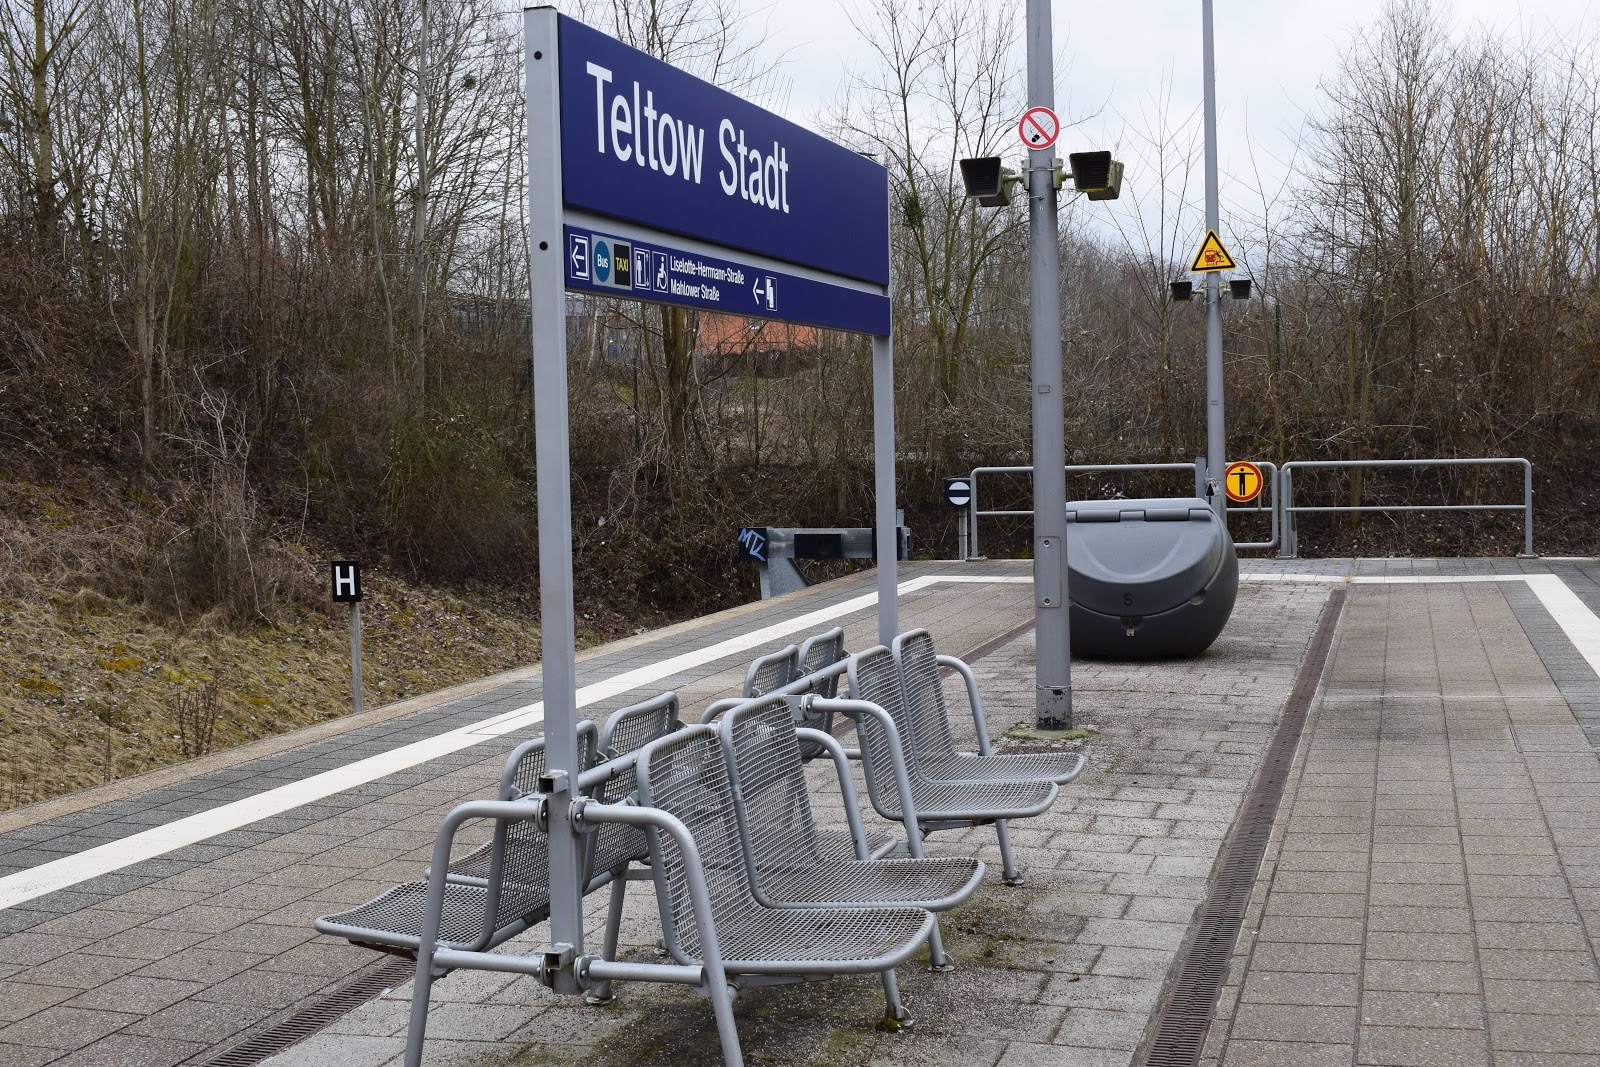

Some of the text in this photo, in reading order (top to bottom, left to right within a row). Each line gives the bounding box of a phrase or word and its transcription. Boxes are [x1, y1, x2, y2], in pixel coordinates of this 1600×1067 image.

[586, 61, 790, 214] Teltow Stadt
[597, 253, 609, 268] Bus
[615, 256, 629, 272] TAXI
[670, 255, 745, 285] Liselotte-Herrmann-Straße
[670, 278, 720, 302] Mahlower Straße
[335, 565, 356, 596] H
[1123, 592, 1133, 607] S
